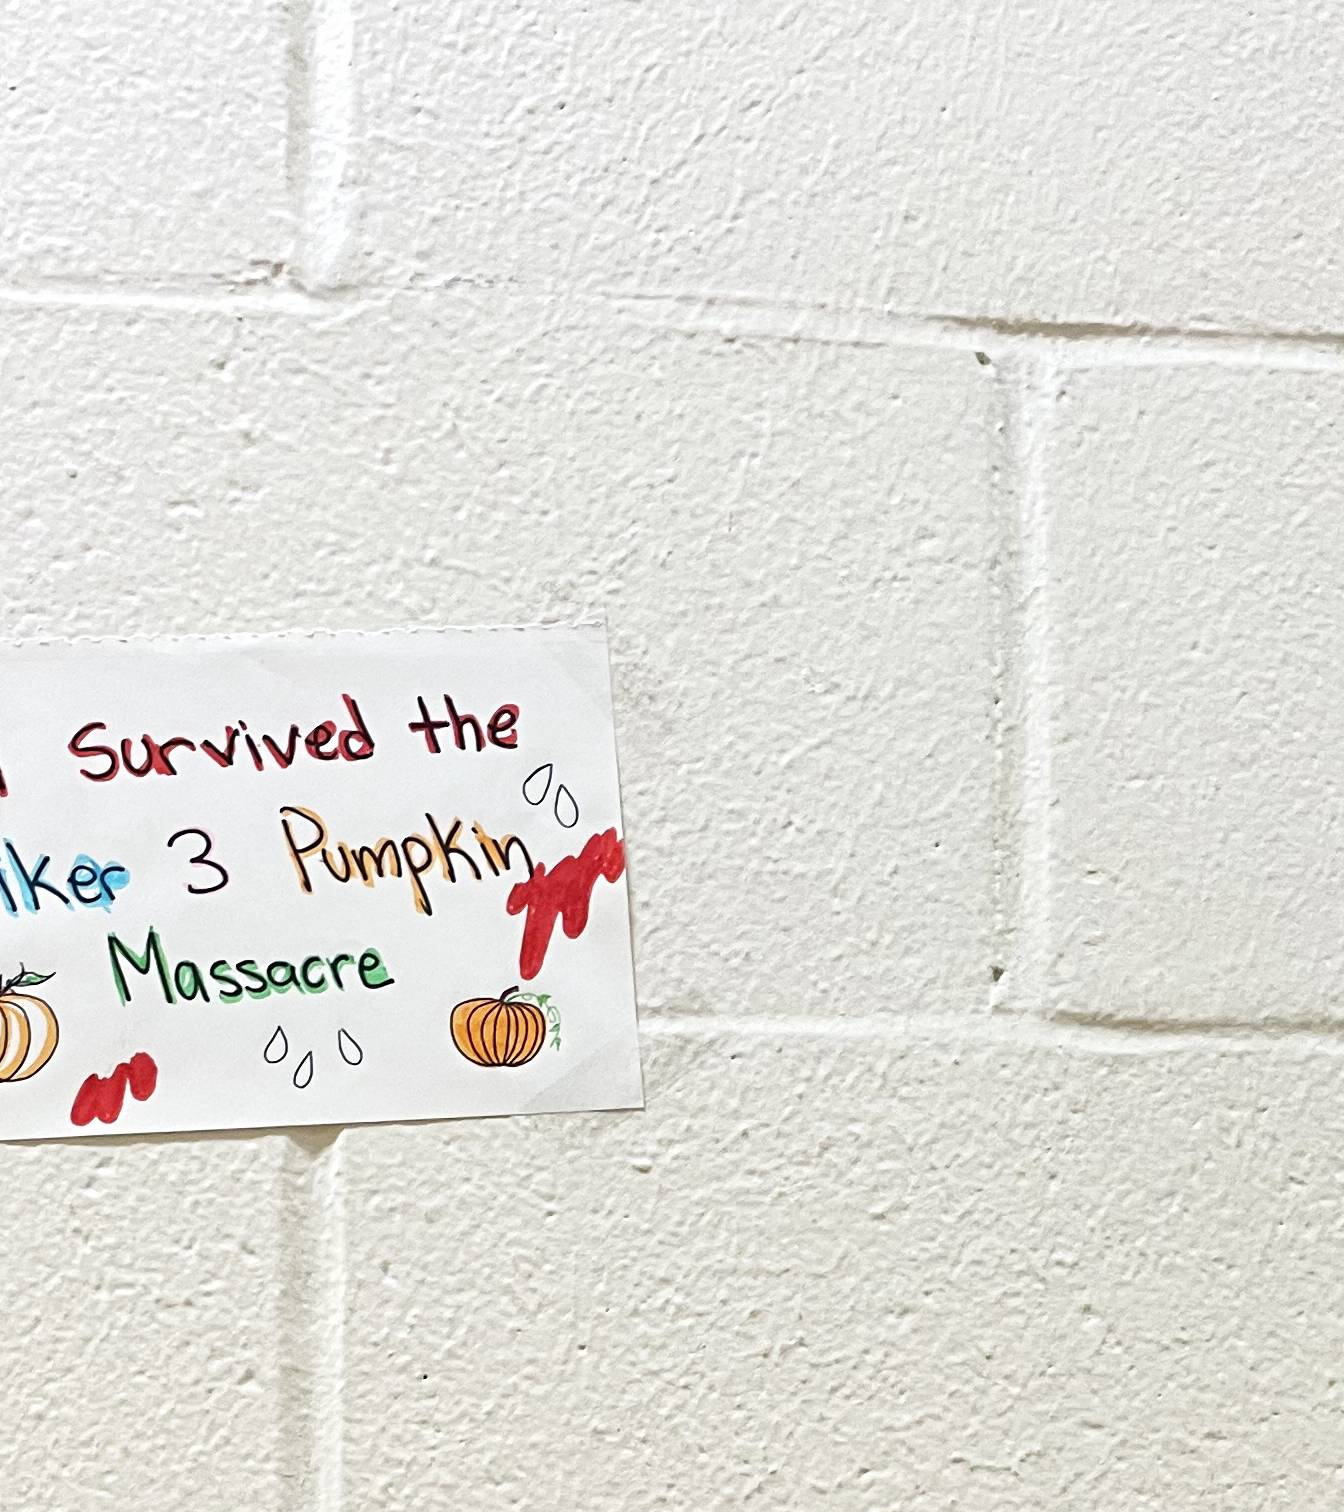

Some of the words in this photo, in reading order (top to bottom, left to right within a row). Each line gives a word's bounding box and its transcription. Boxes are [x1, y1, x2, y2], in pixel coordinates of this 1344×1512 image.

[408, 693, 521, 755] the
[167, 828, 229, 895] 3
[279, 806, 536, 917] Pumpkin
[107, 925, 396, 1005] Massacre
